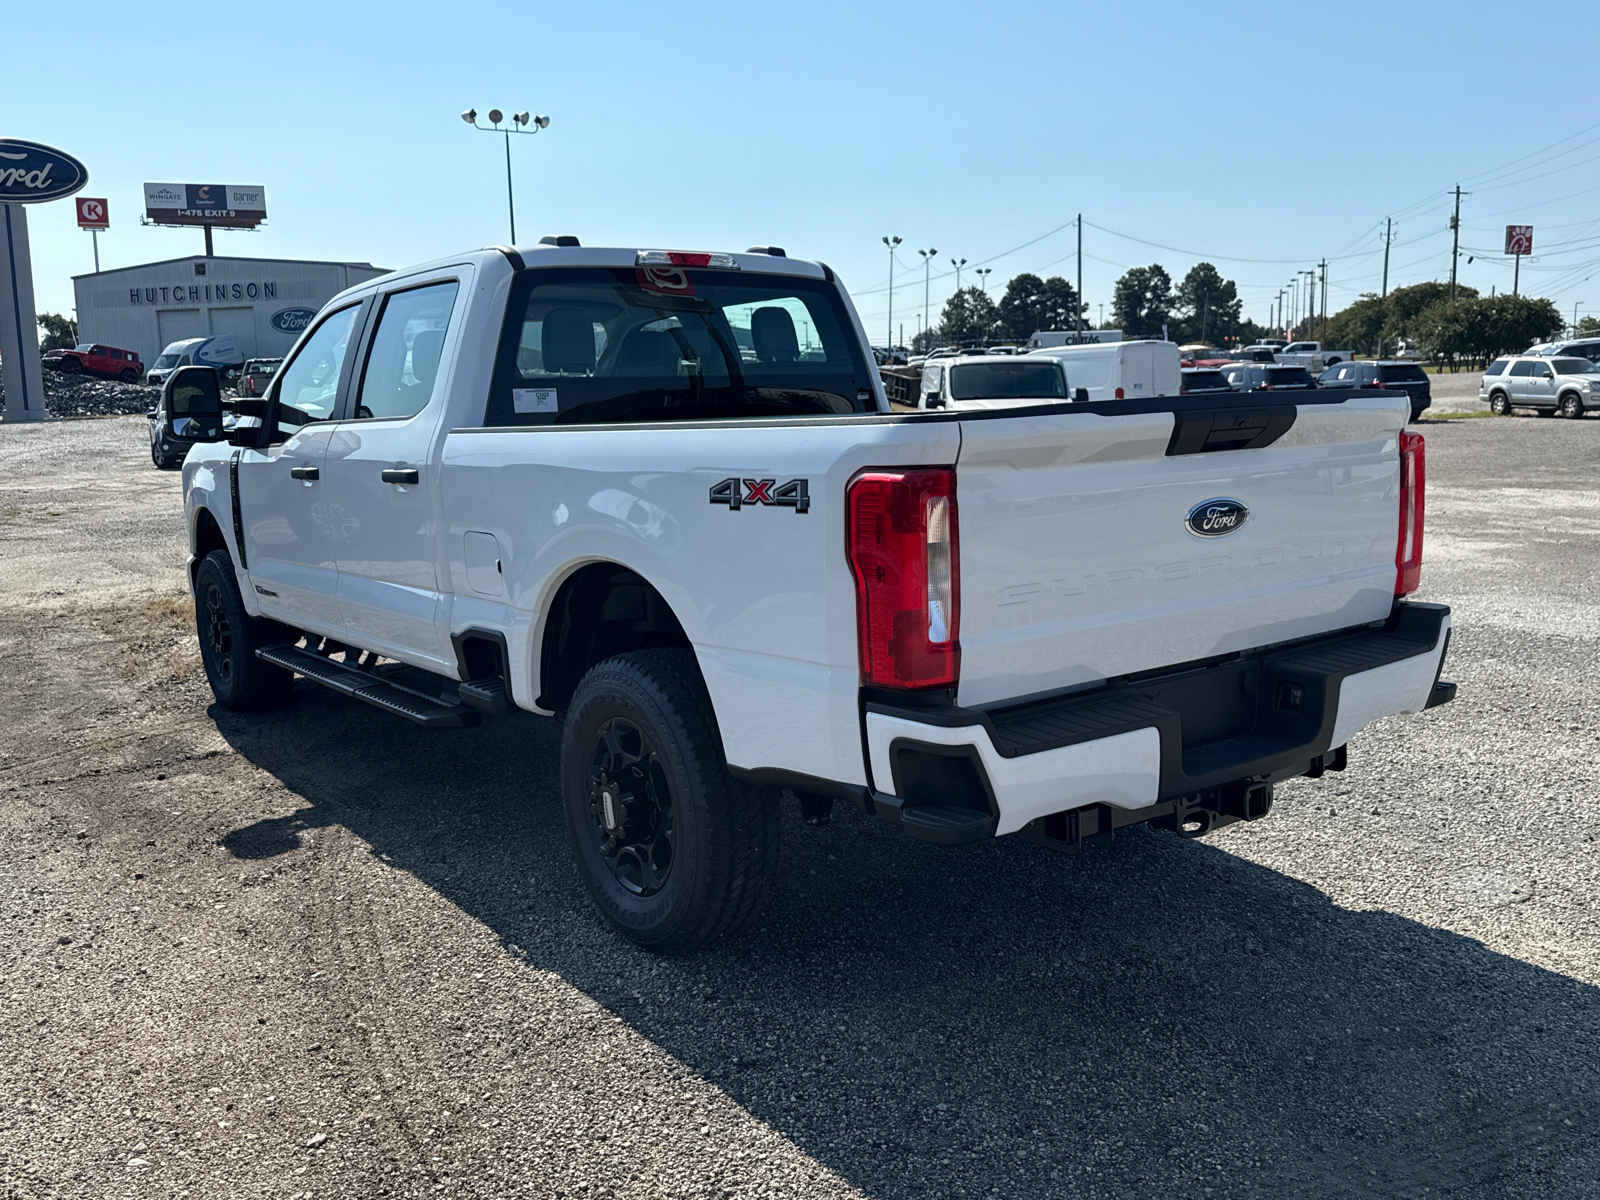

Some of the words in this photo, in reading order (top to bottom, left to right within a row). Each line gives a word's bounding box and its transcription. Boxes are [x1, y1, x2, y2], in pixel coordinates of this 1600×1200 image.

[233, 192, 260, 202] Garner
[87, 205, 100, 218] K
[177, 209, 203, 217] I-475
[204, 210, 228, 218] EXIT
[229, 210, 236, 218] 9
[129, 281, 276, 303] HUTCHINSON
[280, 311, 313, 329] Ford
[1202, 505, 1238, 531] Ford
[997, 554, 1234, 607] SUPER
[1251, 530, 1383, 573] DUTY
